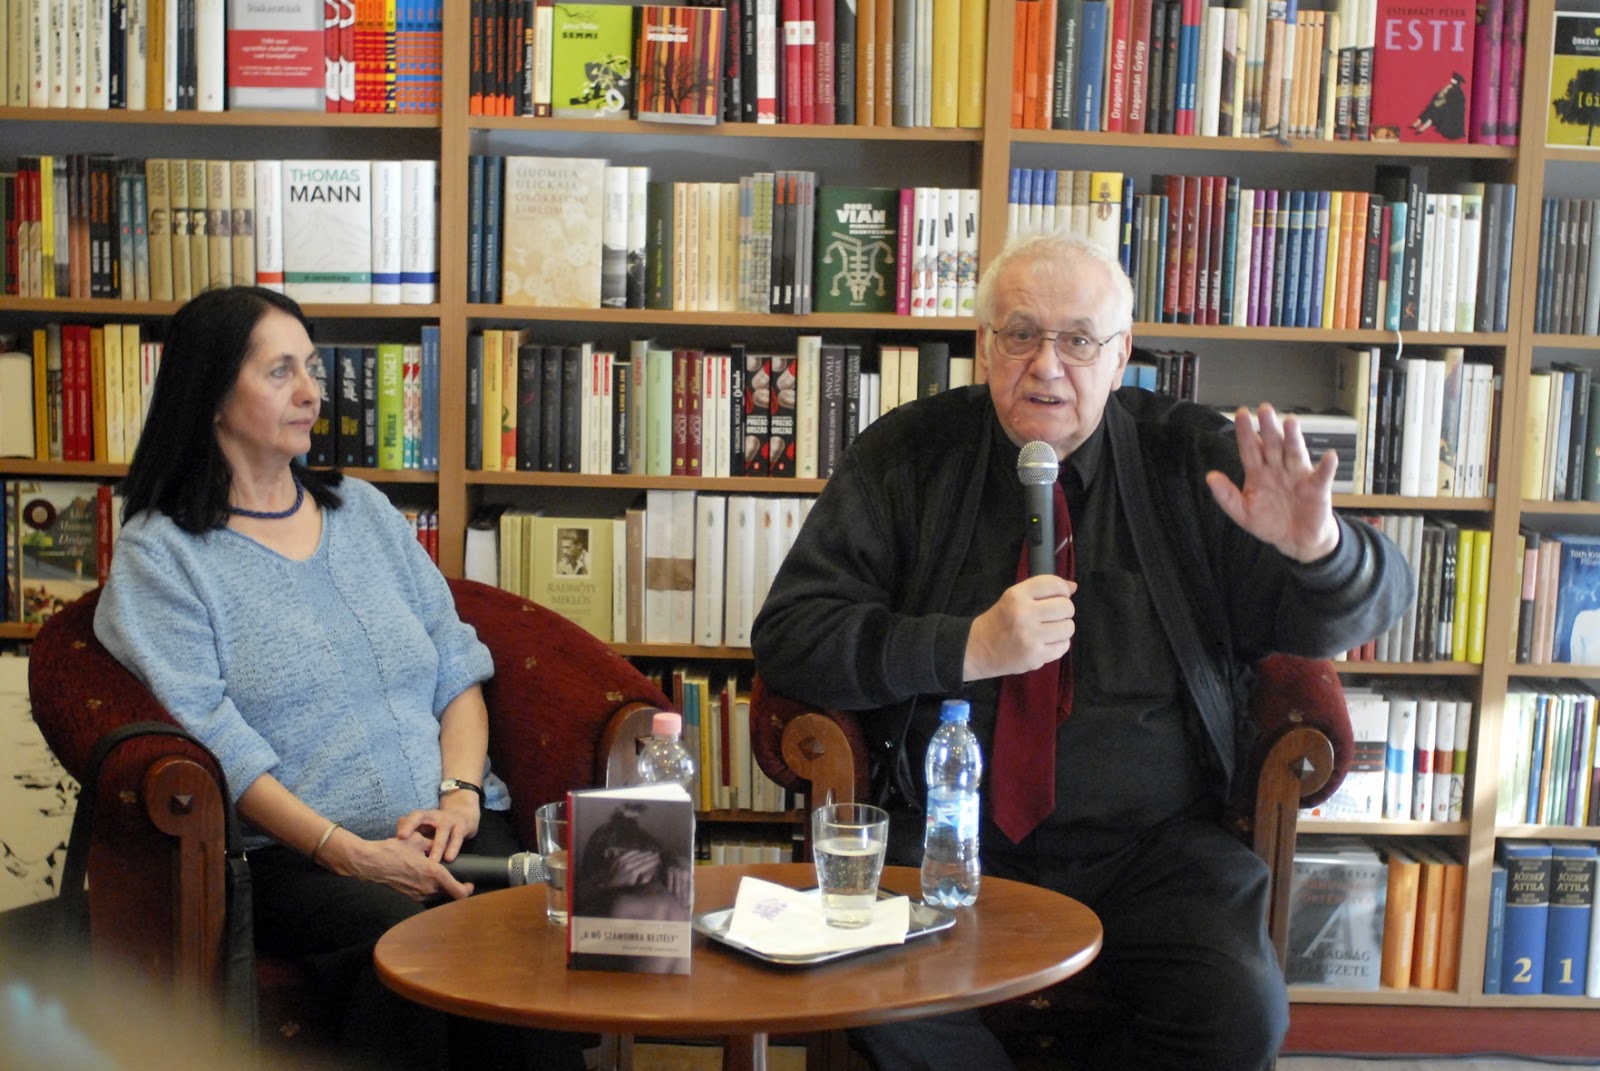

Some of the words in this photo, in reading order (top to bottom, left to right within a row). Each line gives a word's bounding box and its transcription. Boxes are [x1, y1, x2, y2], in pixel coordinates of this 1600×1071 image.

[1385, 19, 1466, 51] ESTI
[1572, 36, 1599, 46] ÖRKÉNY
[1113, 39, 1125, 70] György
[1131, 40, 1145, 71] György
[1339, 51, 1351, 76] PÉTER
[1358, 51, 1369, 76] PÉTER
[1111, 73, 1123, 119] Dragomán
[1130, 74, 1142, 120] Dragomán
[290, 168, 360, 182] THOMAS
[516, 168, 578, 178] LJUDMILA
[516, 180, 578, 190] ULICKAJA
[290, 186, 361, 202] MANN
[836, 209, 886, 223] VIAN
[384, 353, 396, 385] SZIGET
[825, 355, 833, 399] ANGYALI
[733, 370, 743, 397] Orlando
[678, 414, 687, 444] WOOLF
[547, 582, 595, 593] RADNÓTI
[552, 594, 591, 605] MIKLÓS
[1512, 882, 1544, 892] ATTILA
[1513, 872, 1545, 881] JÓZSEF
[1556, 883, 1590, 892] ATTILA
[1558, 872, 1590, 882] JÓZSEF
[1512, 957, 1533, 983] 2
[1559, 958, 1573, 984] 1
